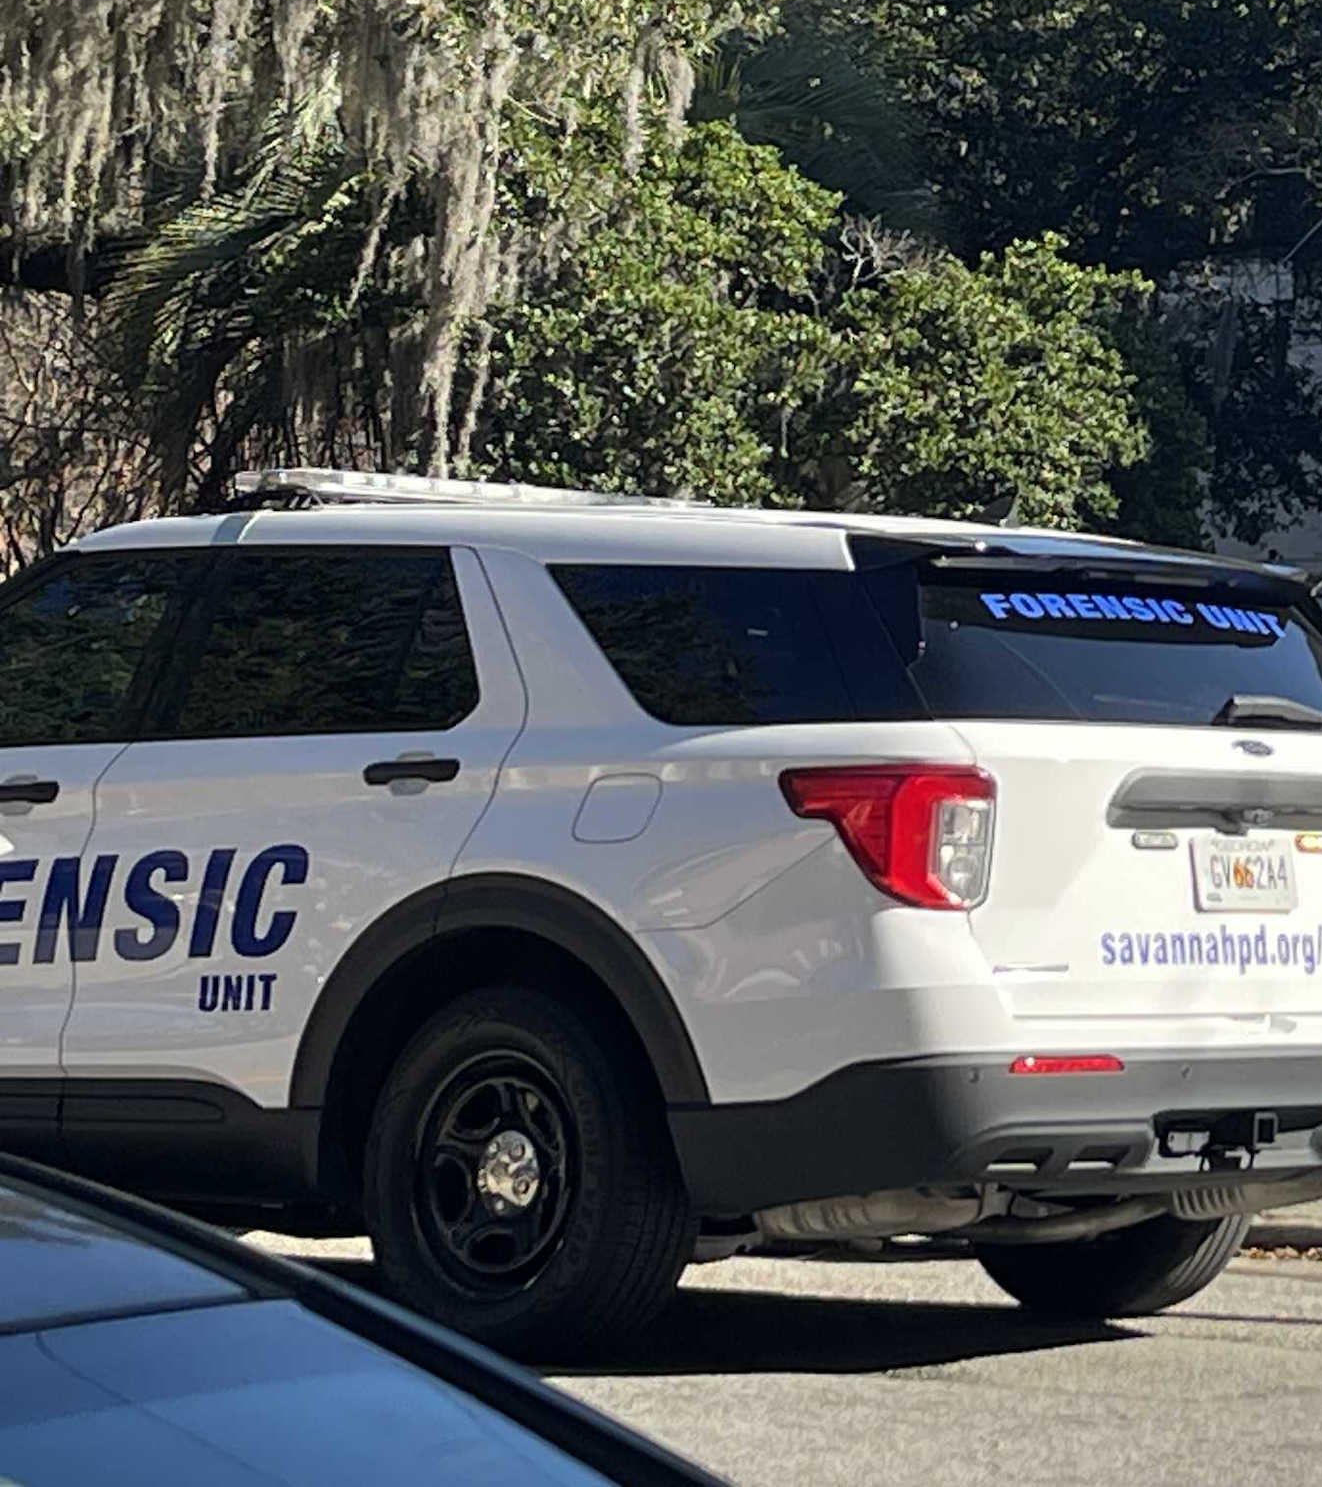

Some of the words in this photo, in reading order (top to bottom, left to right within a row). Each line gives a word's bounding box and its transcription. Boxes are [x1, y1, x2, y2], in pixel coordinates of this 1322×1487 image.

[980, 592, 1194, 625] FORENSIC
[1195, 602, 1287, 639] UNIT
[198, 973, 277, 1012] UNIT
